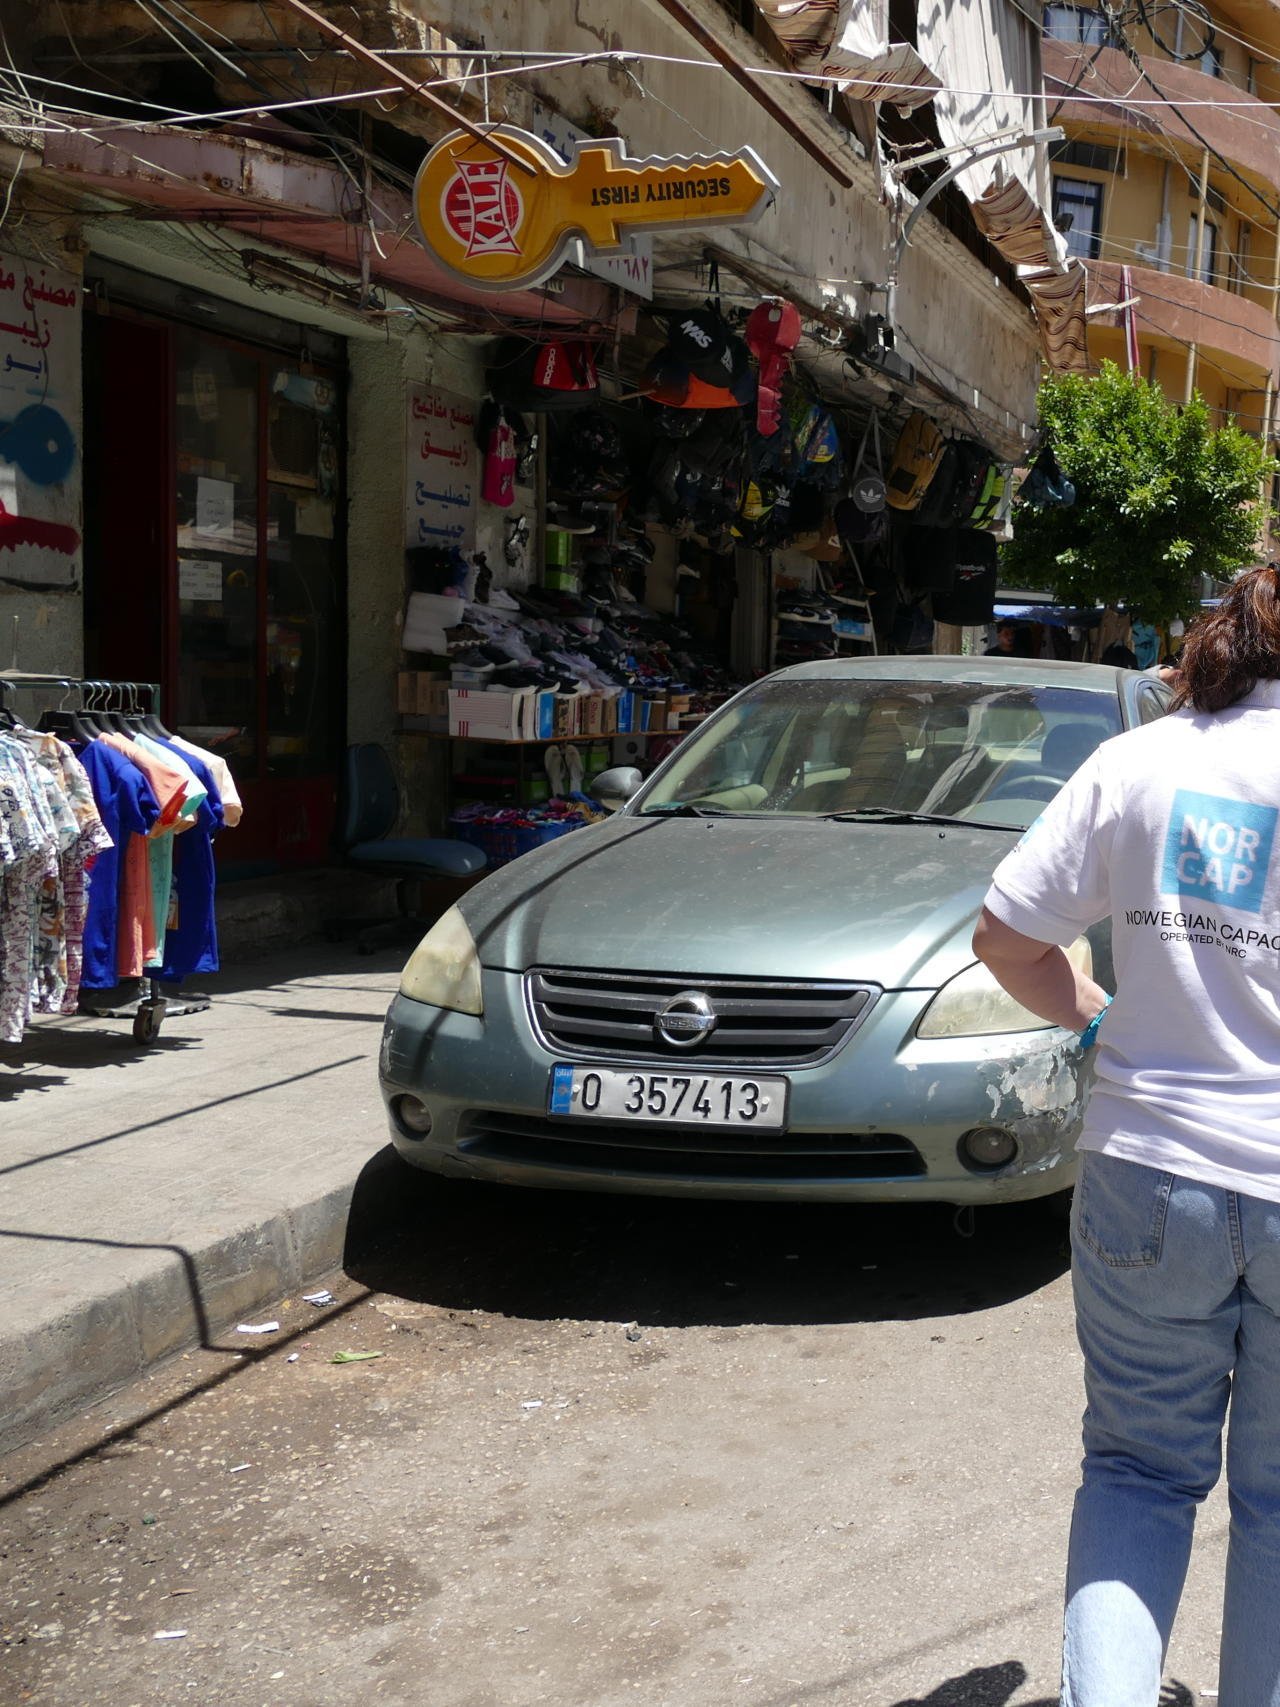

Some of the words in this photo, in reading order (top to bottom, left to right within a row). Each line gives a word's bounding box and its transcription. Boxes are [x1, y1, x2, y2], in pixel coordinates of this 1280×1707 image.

[461, 161, 517, 254] KALE
[591, 184, 640, 207] FIRST
[646, 177, 731, 202] SECURITY
[23, 269, 76, 311] مصنع
[0, 319, 50, 349] زيب
[1180, 813, 1262, 862] NOR
[1175, 851, 1254, 895] CAP
[1159, 931, 1214, 945] OPERATED
[1225, 945, 1248, 959] NRC
[658, 1014, 714, 1030] NISSAN
[624, 1073, 761, 1121] 357413
